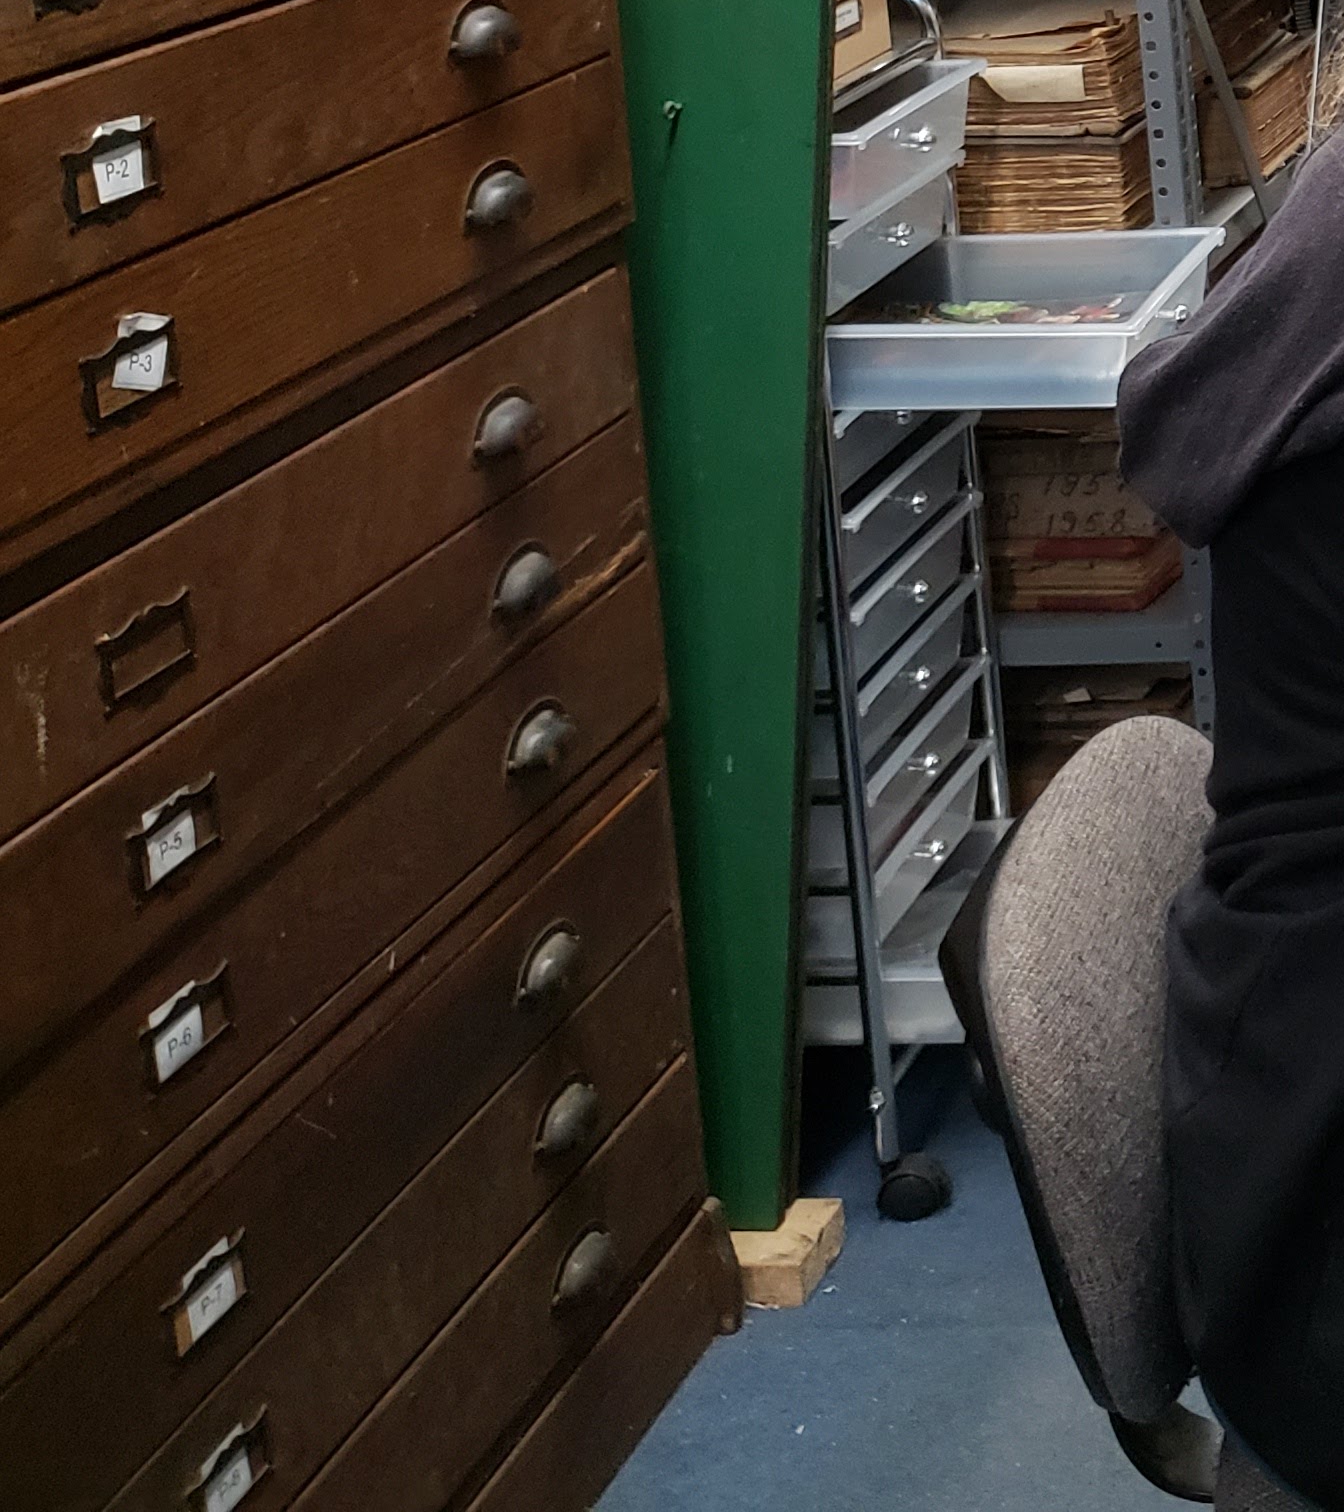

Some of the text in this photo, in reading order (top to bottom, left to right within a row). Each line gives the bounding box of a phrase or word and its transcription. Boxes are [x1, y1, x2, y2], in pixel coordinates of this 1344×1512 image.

[103, 157, 131, 184] P-2
[127, 352, 155, 374] P-3
[158, 831, 186, 862] P-5
[165, 1026, 194, 1060] P-6
[198, 1280, 227, 1319] P-7
